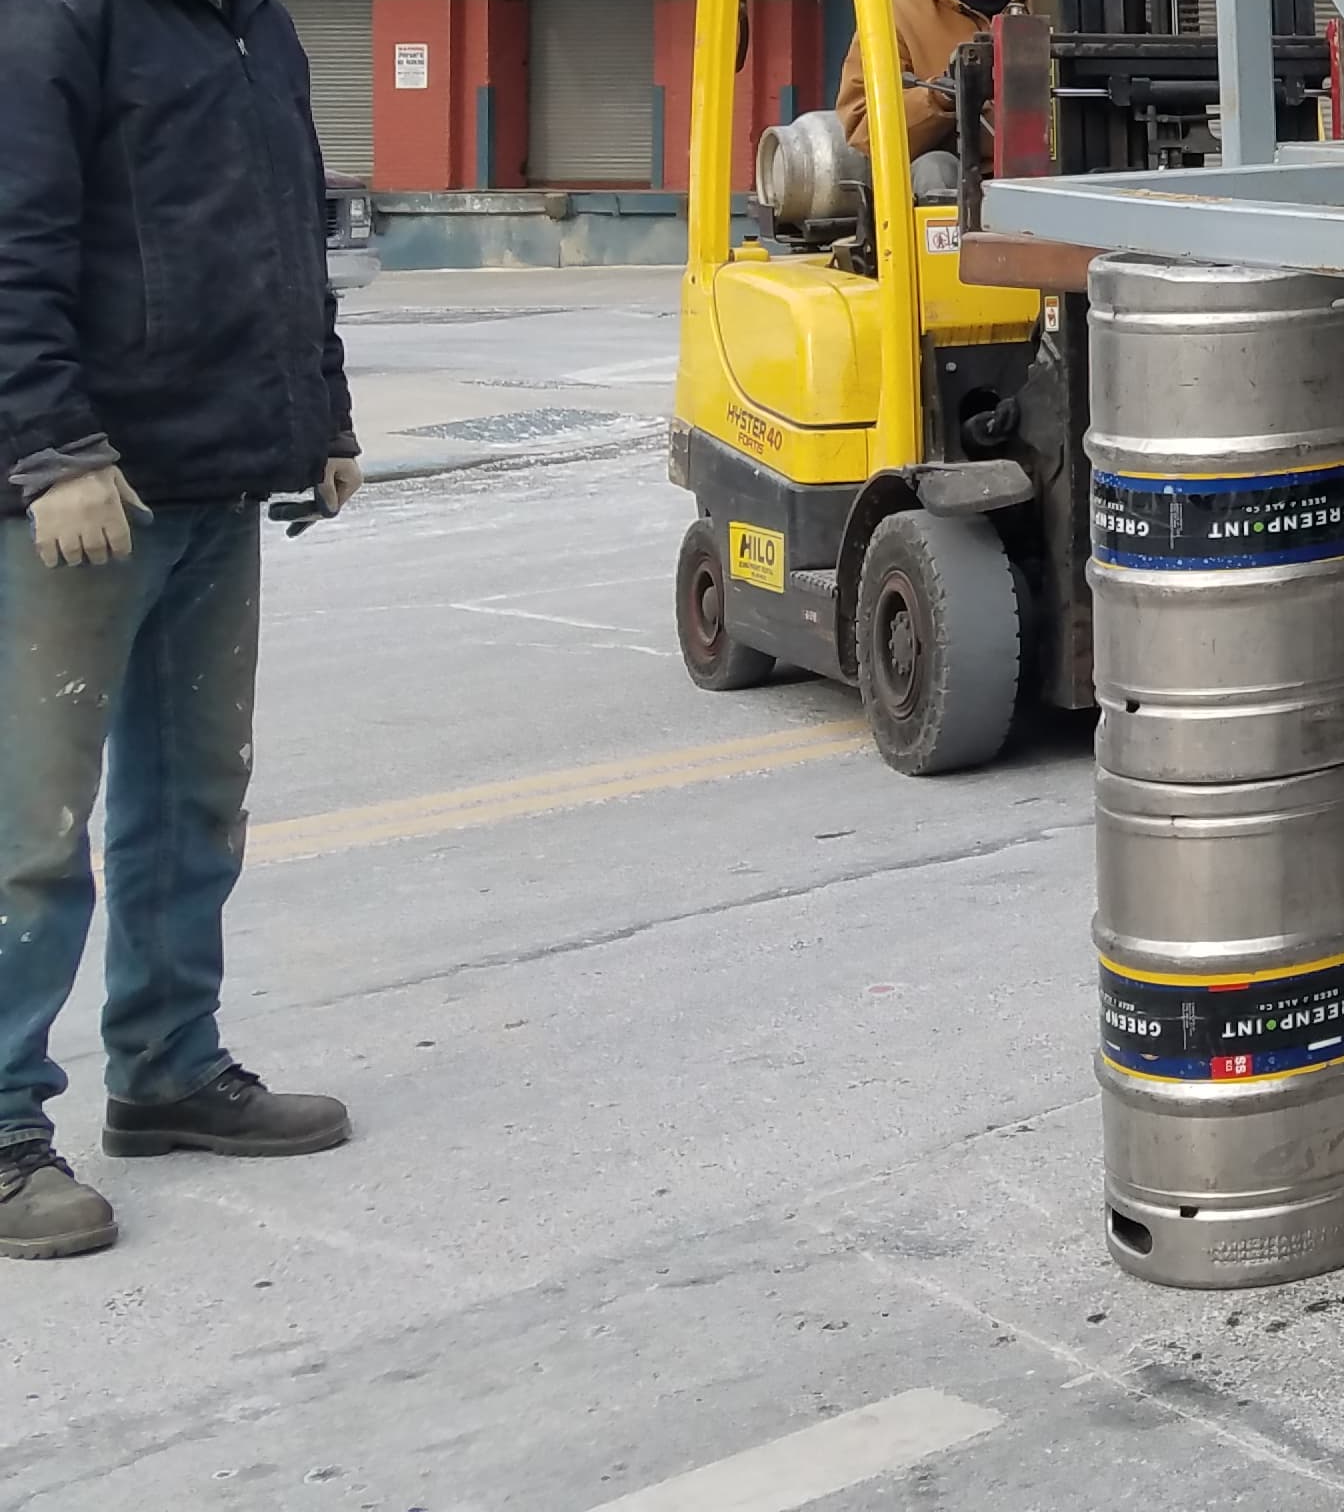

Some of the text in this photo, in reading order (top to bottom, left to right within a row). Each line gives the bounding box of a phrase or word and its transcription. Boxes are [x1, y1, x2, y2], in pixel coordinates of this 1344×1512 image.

[726, 401, 783, 451] HYSTER 40
[739, 533, 775, 566] HILO
